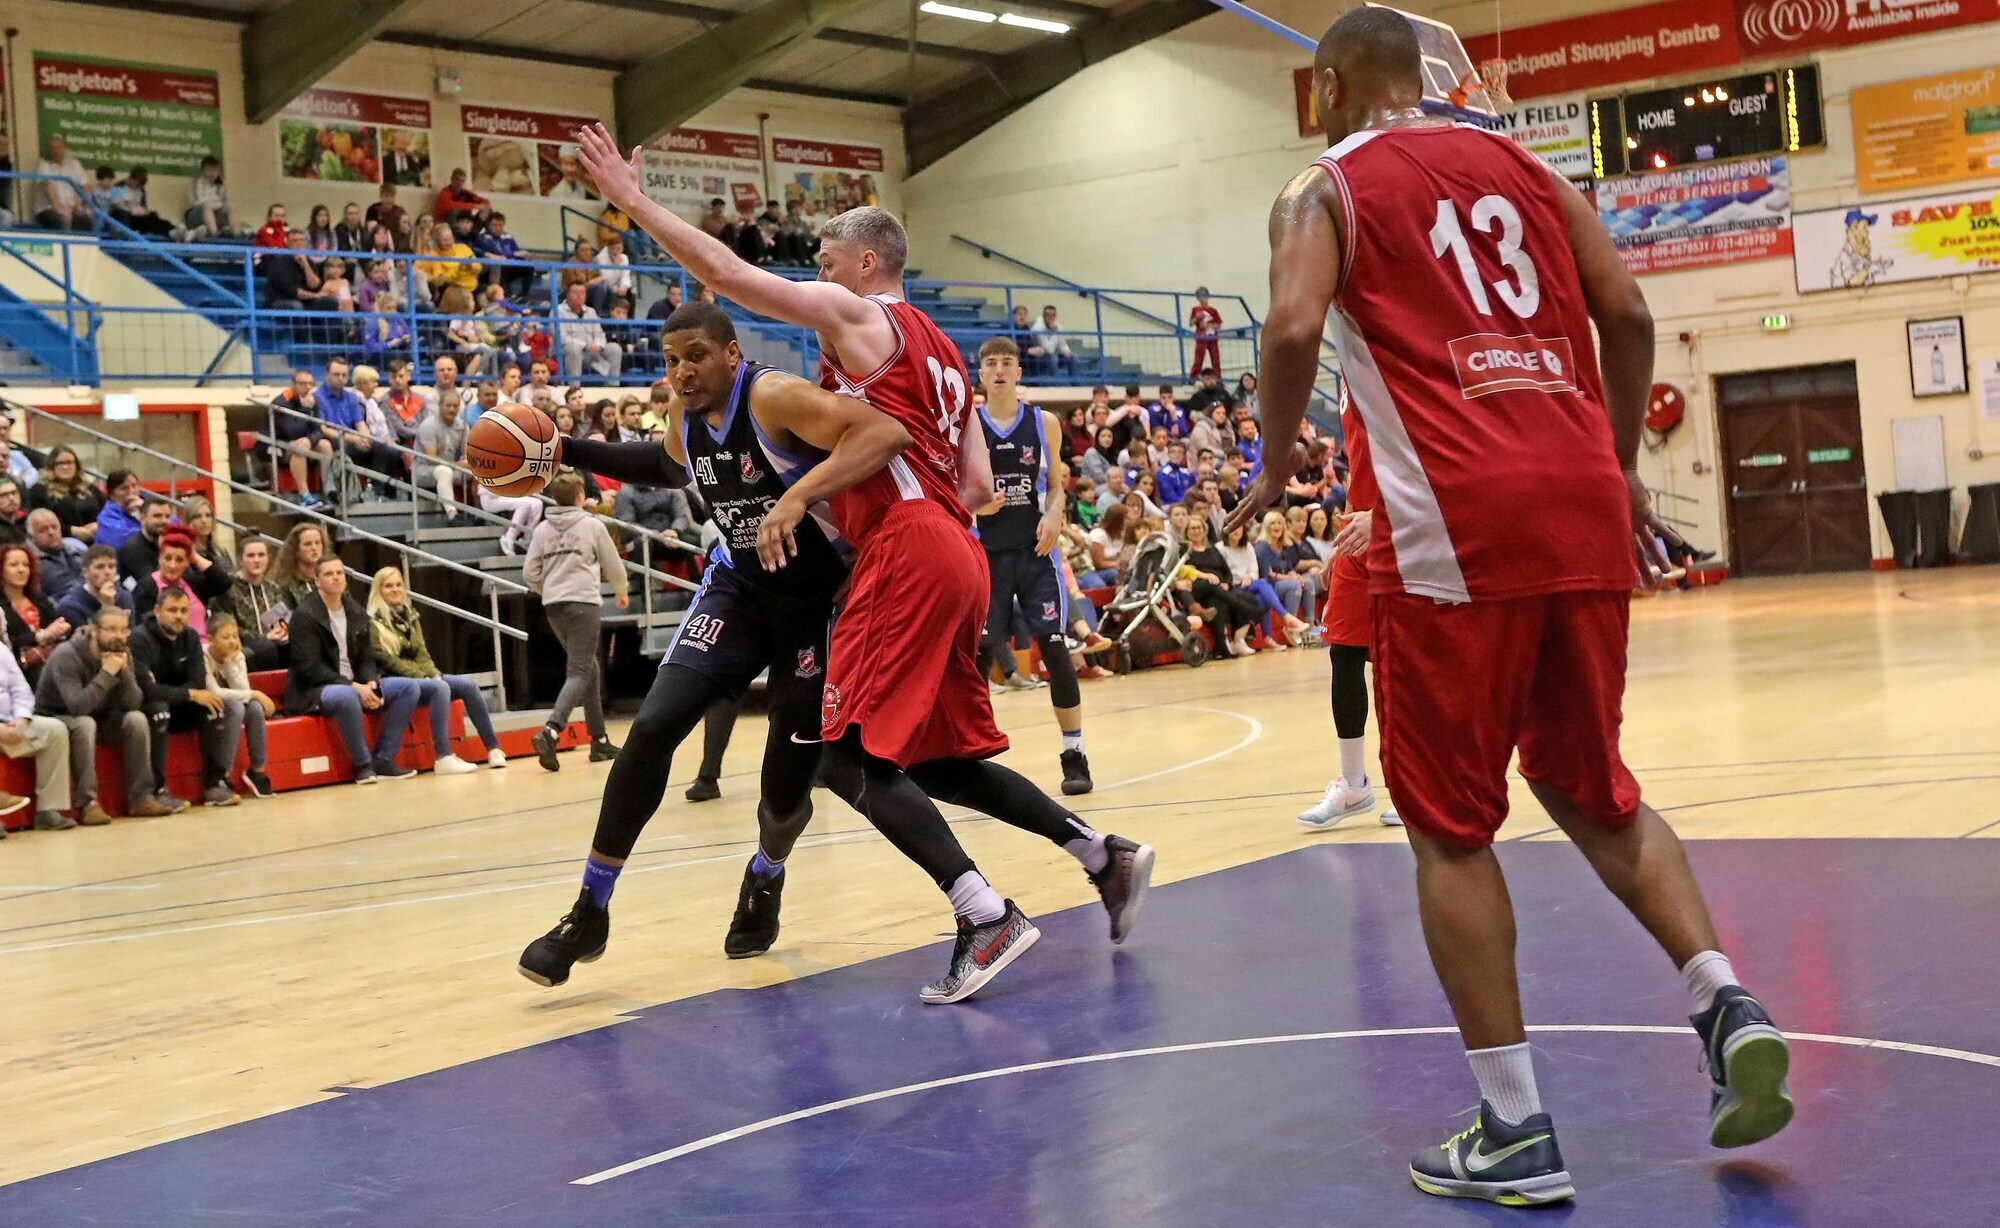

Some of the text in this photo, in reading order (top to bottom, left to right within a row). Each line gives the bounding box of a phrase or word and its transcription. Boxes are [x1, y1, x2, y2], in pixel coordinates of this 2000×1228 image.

[1571, 34, 1655, 63] Shopping
[1658, 23, 1721, 48] Centre
[39, 66, 138, 93] Singleton's
[466, 111, 538, 134] Singleton's
[1525, 102, 1580, 126] FIELD
[1638, 93, 1768, 130] HOME GUEST
[646, 173, 676, 189] SAVE
[1611, 160, 1772, 195] MALCOLM THOMPSON
[1635, 179, 1750, 206] TILING SERVICES
[1892, 200, 1993, 228] SAVE
[1429, 194, 1541, 319] 13
[695, 456, 719, 486] 41
[686, 613, 725, 646] 41
